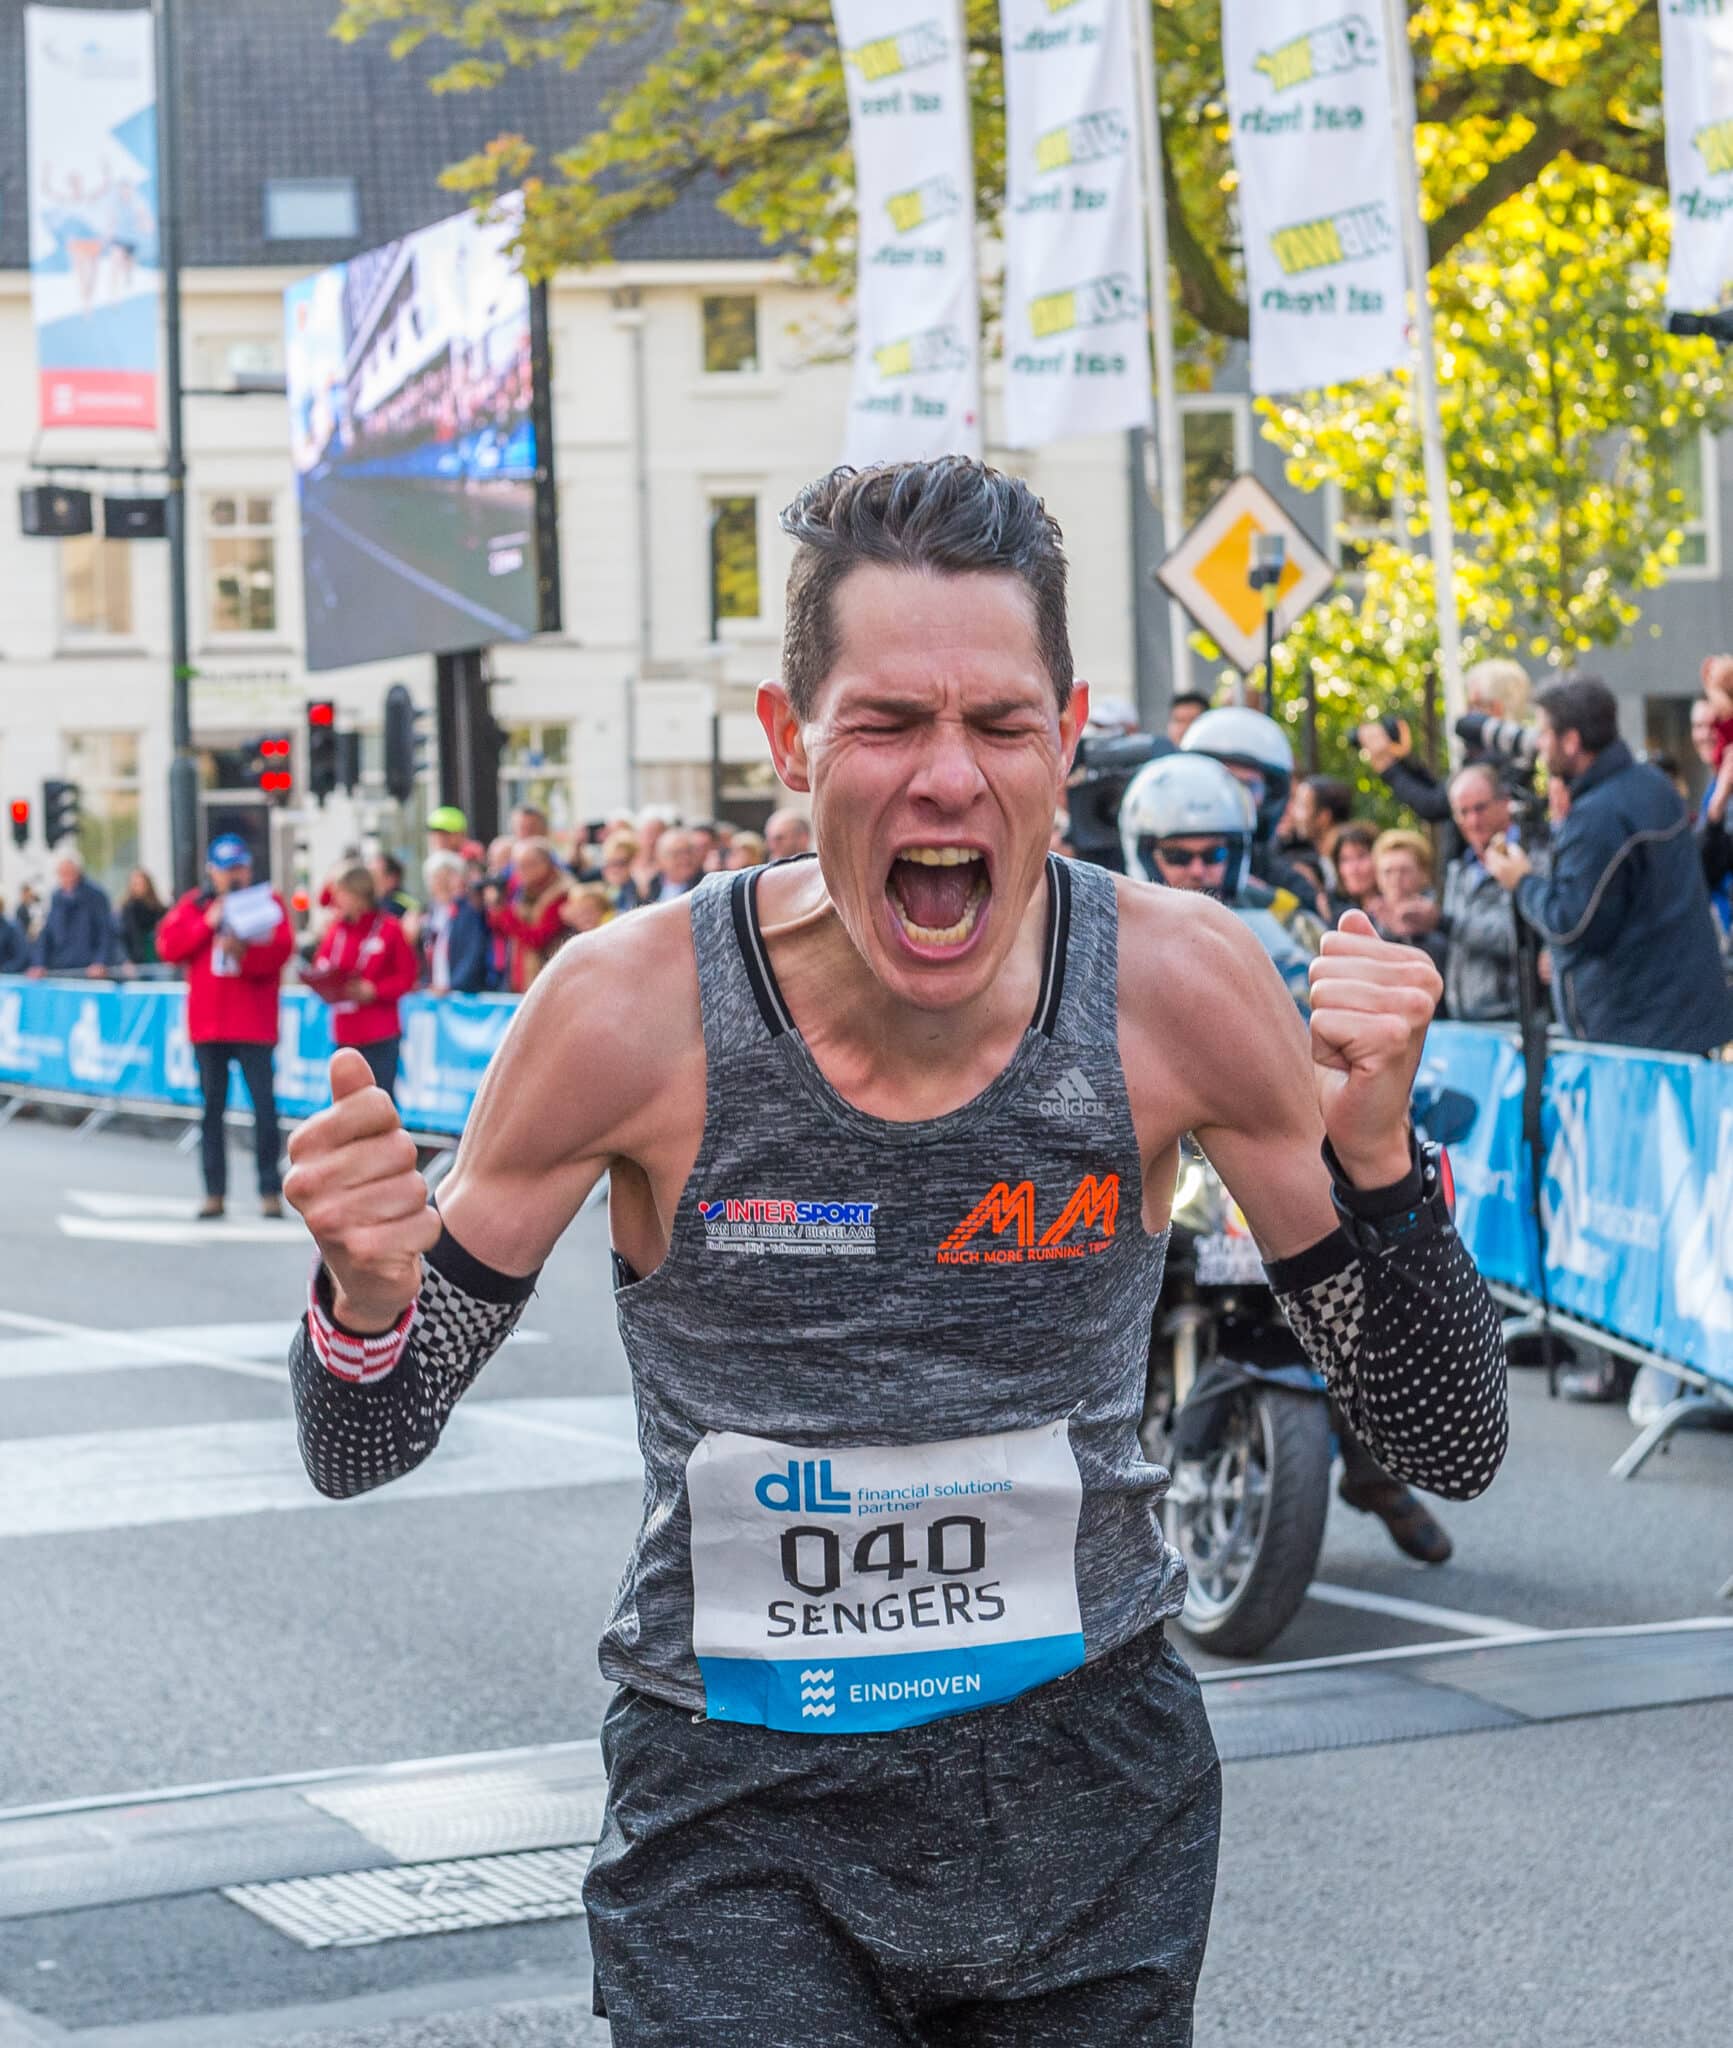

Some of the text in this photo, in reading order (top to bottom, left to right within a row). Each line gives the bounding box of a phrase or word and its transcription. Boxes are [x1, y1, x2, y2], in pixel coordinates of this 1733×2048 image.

[1039, 1097, 1107, 1117] adidas
[726, 1199, 874, 1226] INTERSPORT
[704, 1222, 730, 1237] VAN
[731, 1223, 755, 1237] DEN
[937, 1250, 980, 1265] MUCH
[983, 1249, 1024, 1264] MORE
[1027, 1244, 1086, 1262] RUNNING
[857, 1479, 1013, 1500] financial solutions
[857, 1500, 923, 1517] partner
[780, 1515, 987, 1597] 040
[767, 1581, 1006, 1638] SENGERS
[849, 1673, 981, 1703] EINDHOVEN
